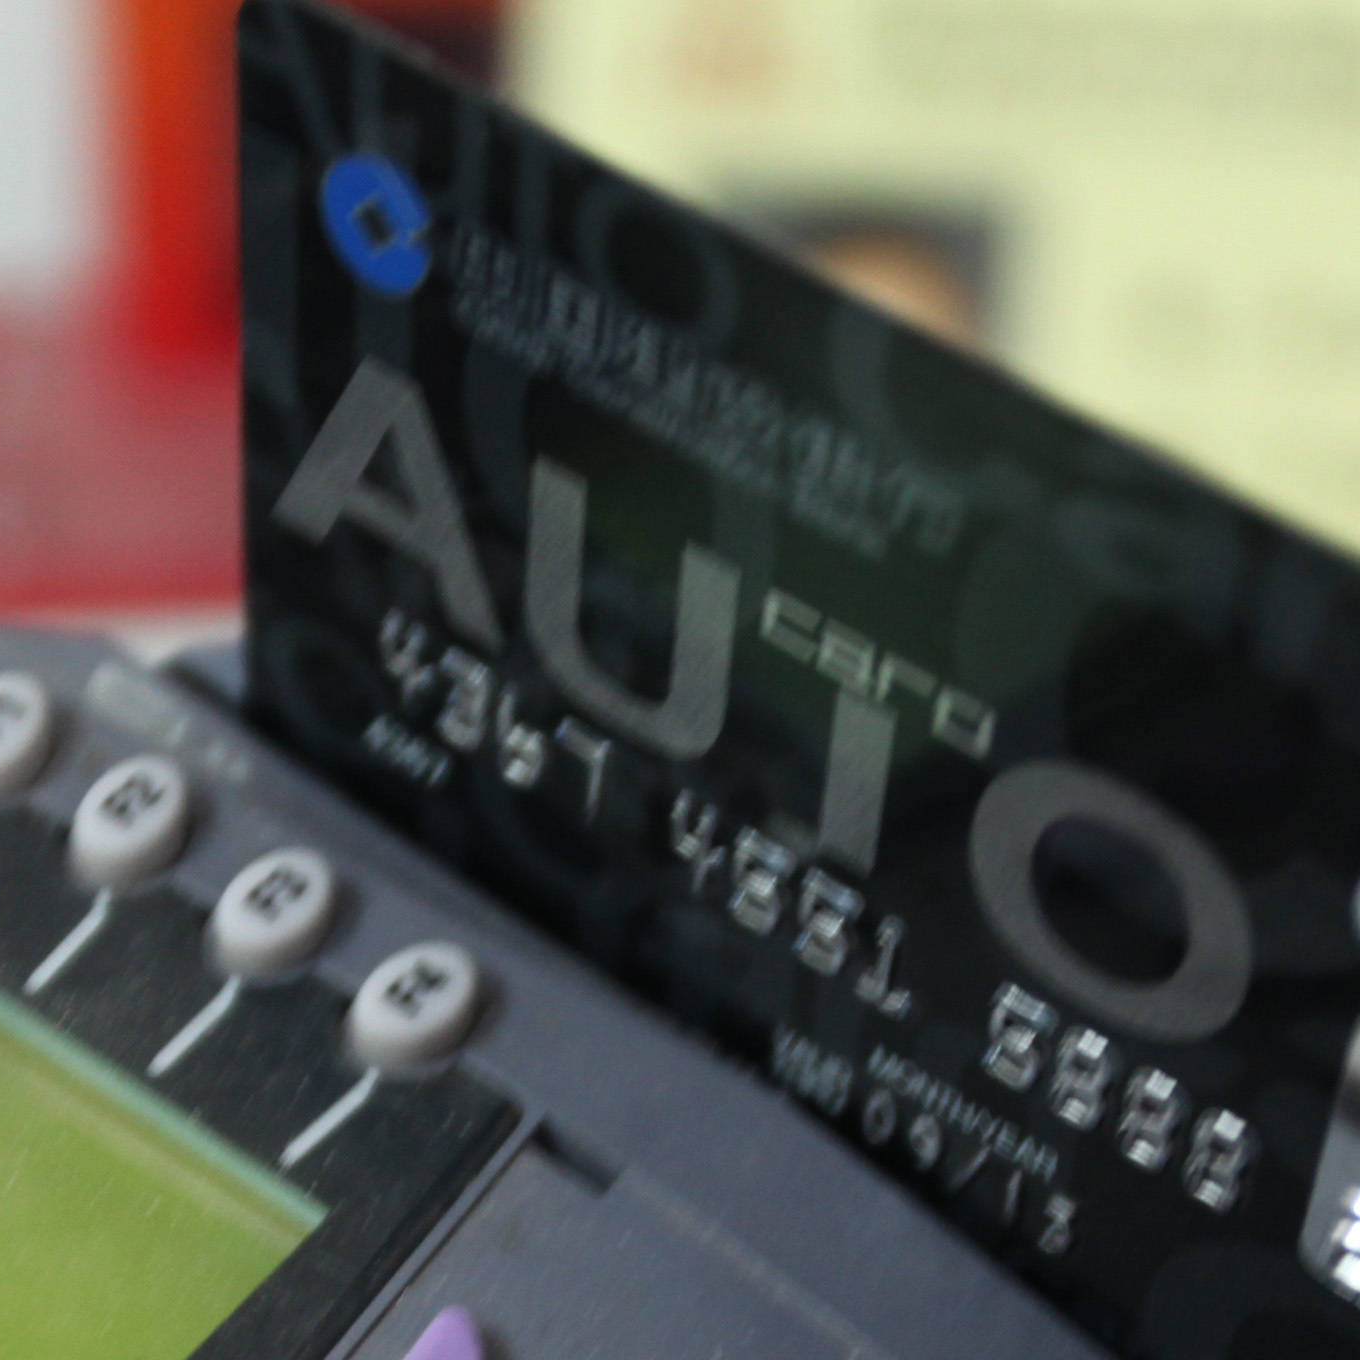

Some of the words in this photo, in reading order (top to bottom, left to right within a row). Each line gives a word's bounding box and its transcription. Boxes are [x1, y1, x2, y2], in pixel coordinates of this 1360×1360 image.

[273, 355, 1252, 1044] AUTO
[103, 764, 167, 828] F2
[246, 865, 309, 923] F3
